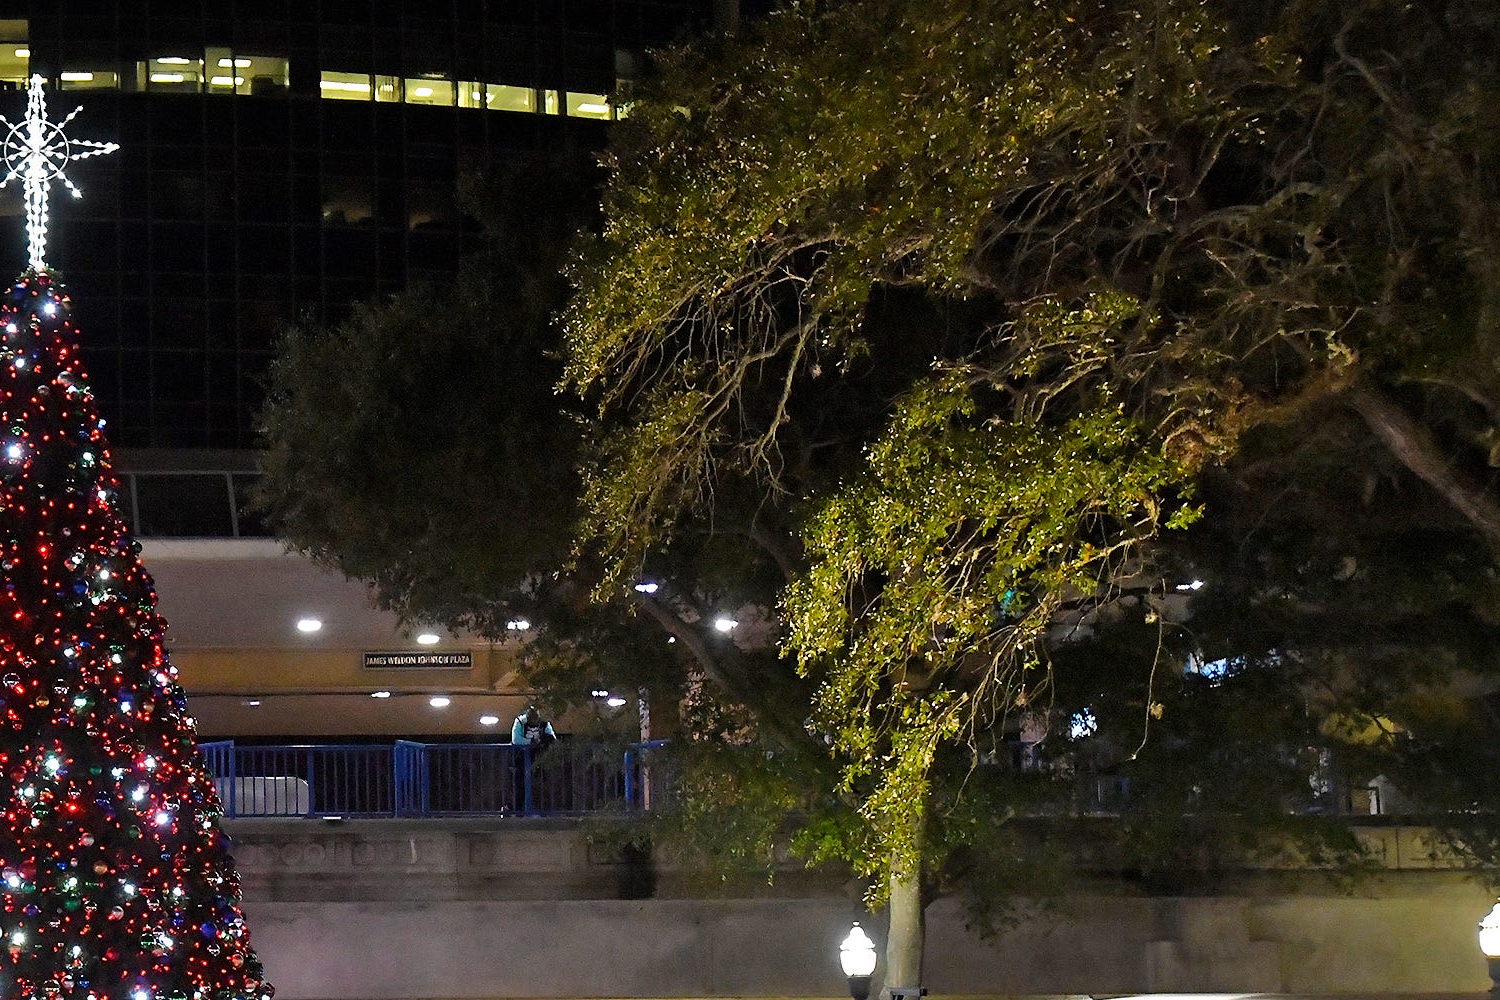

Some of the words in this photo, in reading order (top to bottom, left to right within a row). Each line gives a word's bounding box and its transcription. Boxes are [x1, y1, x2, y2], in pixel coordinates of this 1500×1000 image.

[366, 656, 386, 664] JAMES
[388, 656, 416, 664] WELDON
[417, 656, 449, 664] JOHNSON
[450, 655, 470, 664] PLAZA
